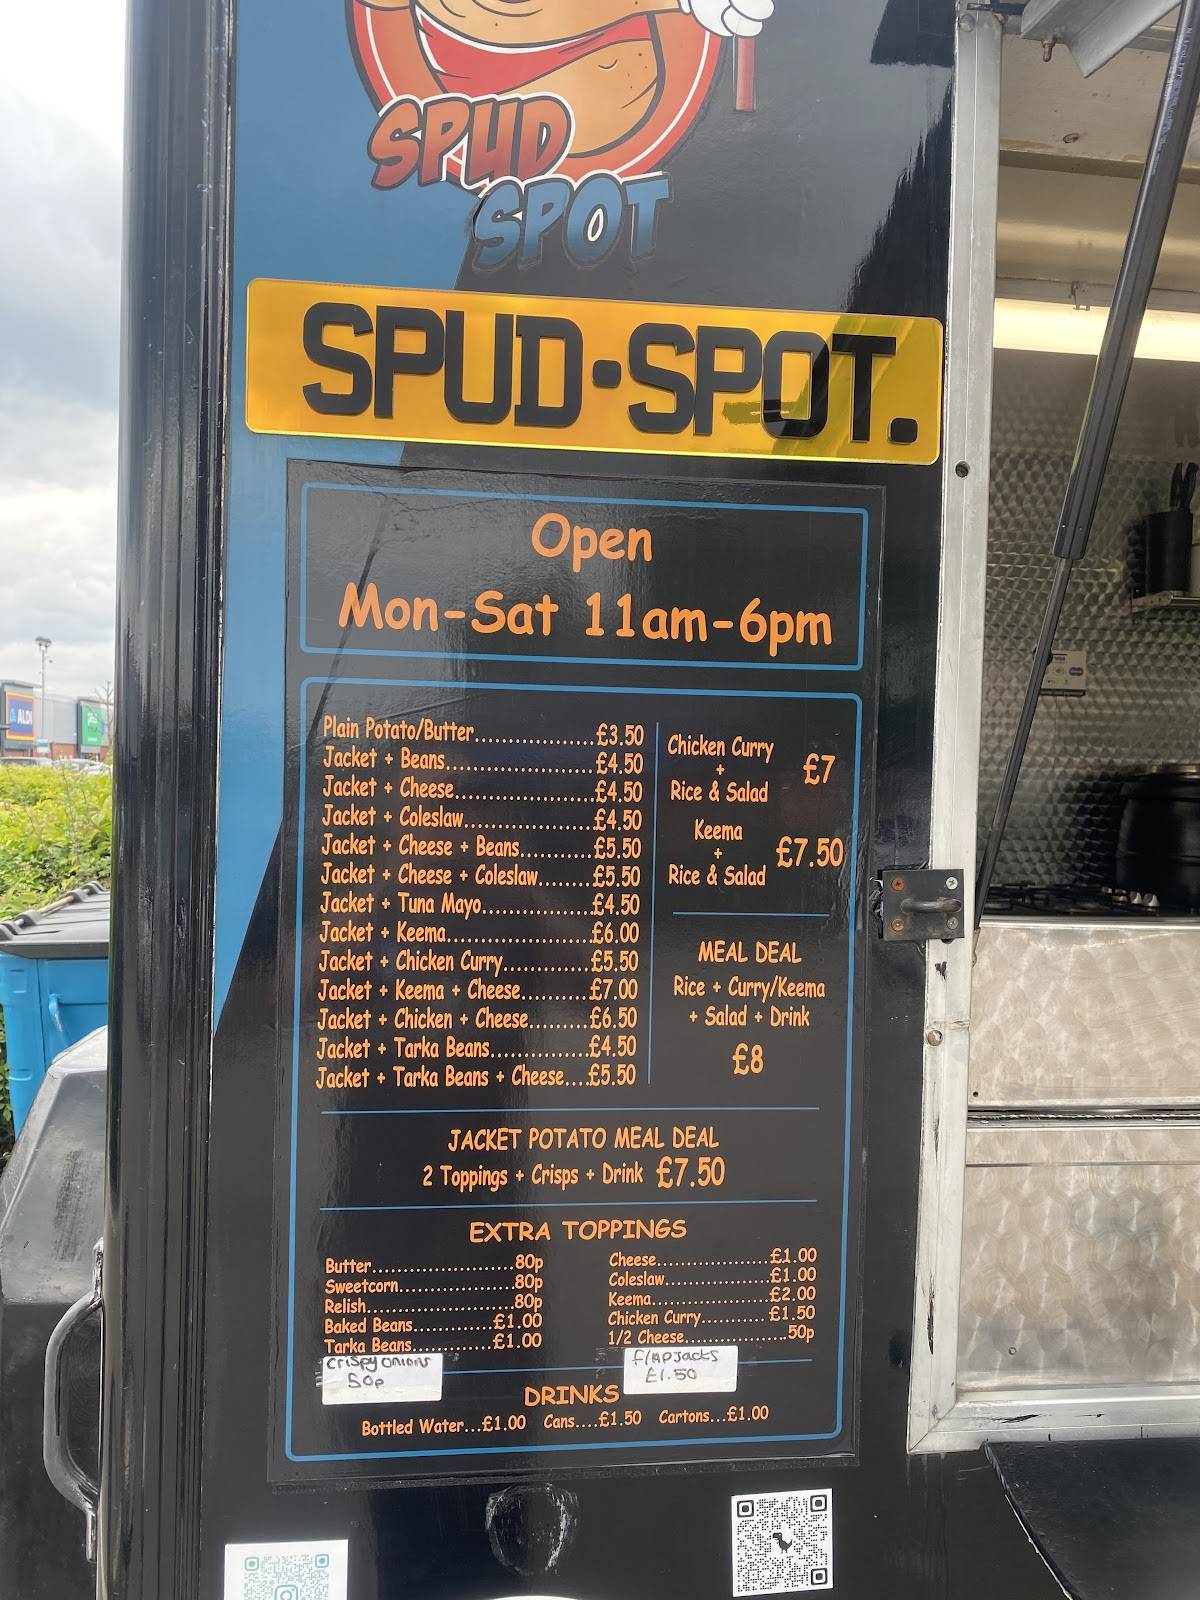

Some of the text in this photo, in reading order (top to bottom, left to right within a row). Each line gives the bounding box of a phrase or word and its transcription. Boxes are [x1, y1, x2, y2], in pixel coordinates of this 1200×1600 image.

[368, 95, 571, 190] SPUD
[473, 173, 670, 271] SPOT
[531, 512, 652, 574] Open
[339, 583, 832, 656] Mon-Sat 11am-6pm
[323, 715, 643, 746] Plain Potato/Butter £3.50
[323, 744, 643, 775] Jacket + Beans £4.50
[668, 734, 773, 761] Chicken Curry
[716, 764, 725, 774] +
[803, 753, 835, 785] £7
[323, 775, 642, 803] Jacket + Cheese £4.50
[671, 780, 768, 802] Rice & Salad
[321, 804, 642, 831] Jacket + Coleslaw £4.50
[695, 819, 742, 840] Keema
[322, 832, 641, 859] Jacket + Cheese + Beans £5.50
[714, 849, 721, 857] +
[776, 836, 843, 867] £7.50
[321, 862, 640, 887] Jacket + Cheese + Coleslaw £5.50
[669, 864, 766, 886] Rice & Salad
[320, 890, 640, 919] Jacket + Tuna Mayo £4.50
[320, 920, 639, 944] Jacket + Keema £6.00
[319, 949, 638, 976] Jacket + Chicken Curry £5.50
[698, 940, 800, 963] MEAL DEAL
[318, 978, 638, 1001] Jacket + Keema + Cheese £7.00
[673, 976, 825, 1002] Rice + Curry/Keema
[317, 1006, 637, 1031] Jacket + Chicken + Cheese £6.50
[690, 1006, 809, 1027] + Salad + Drink
[315, 1034, 636, 1060] Jacket + Tarka Beans £4.50
[732, 1043, 764, 1075] £8
[316, 1063, 636, 1088] Jacket + Tarka Beans + Cheese £5.50
[448, 1125, 718, 1151] JACKET POTATO MEAL DEAL
[423, 1156, 725, 1192] 2 Toppings + Crisps + Drink £7.50
[470, 1219, 688, 1243] EXTRA TOPPINGS
[326, 1254, 543, 1273] Butter 80p
[608, 1248, 816, 1267] Cheese £1.00
[326, 1274, 543, 1294] Sweetcorn 80p
[609, 1267, 816, 1287] Coleslaw £1.00
[325, 1292, 543, 1313] Relish 80p
[609, 1286, 816, 1306] Keema £2.00
[325, 1313, 543, 1334] Baked Beans £1.00
[608, 1305, 815, 1327] Chicken Curry £1.50
[324, 1333, 542, 1354] Tarka Beans £1.00
[609, 1324, 814, 1344] 1/2 Cheese 50p
[525, 1384, 619, 1406] DRINKS
[362, 1406, 768, 1436] Bottled Water £1.00 Cans £1.50 Cartons £1.00
